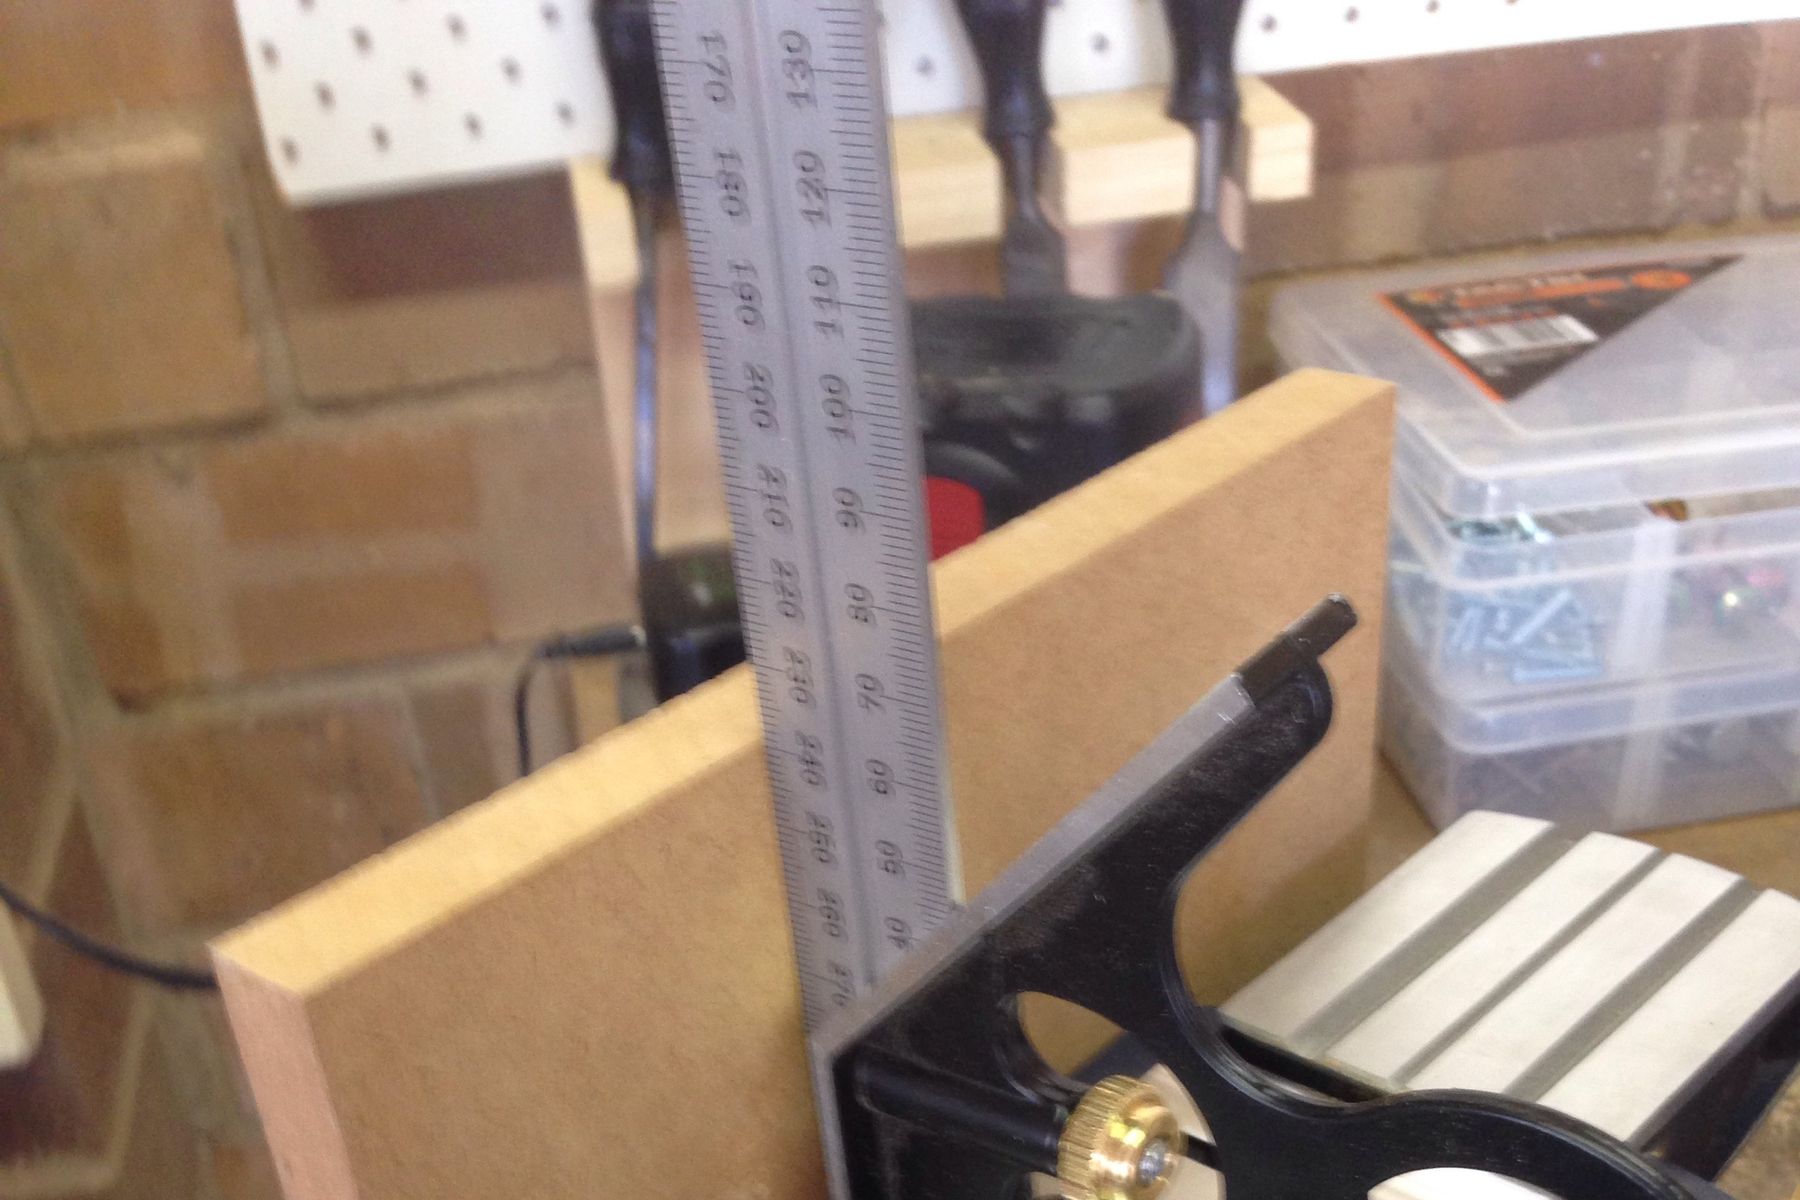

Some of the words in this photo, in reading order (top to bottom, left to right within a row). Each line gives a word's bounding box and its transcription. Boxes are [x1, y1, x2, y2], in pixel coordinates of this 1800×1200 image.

[701, 29, 735, 110] 170
[778, 29, 818, 109] 130
[714, 149, 750, 221] 180
[793, 150, 831, 230] 120
[727, 259, 766, 330] 190
[806, 264, 844, 338] 110
[743, 361, 780, 434] 200
[819, 373, 856, 443] 100
[757, 462, 793, 532] 210
[832, 487, 866, 533] 90
[770, 557, 805, 623] 220
[844, 582, 877, 626] 80
[855, 672, 886, 713] 70
[795, 730, 827, 791] 240
[866, 758, 896, 797] 60
[806, 810, 839, 868] 250
[874, 839, 906, 879] 50
[817, 886, 849, 943] 260
